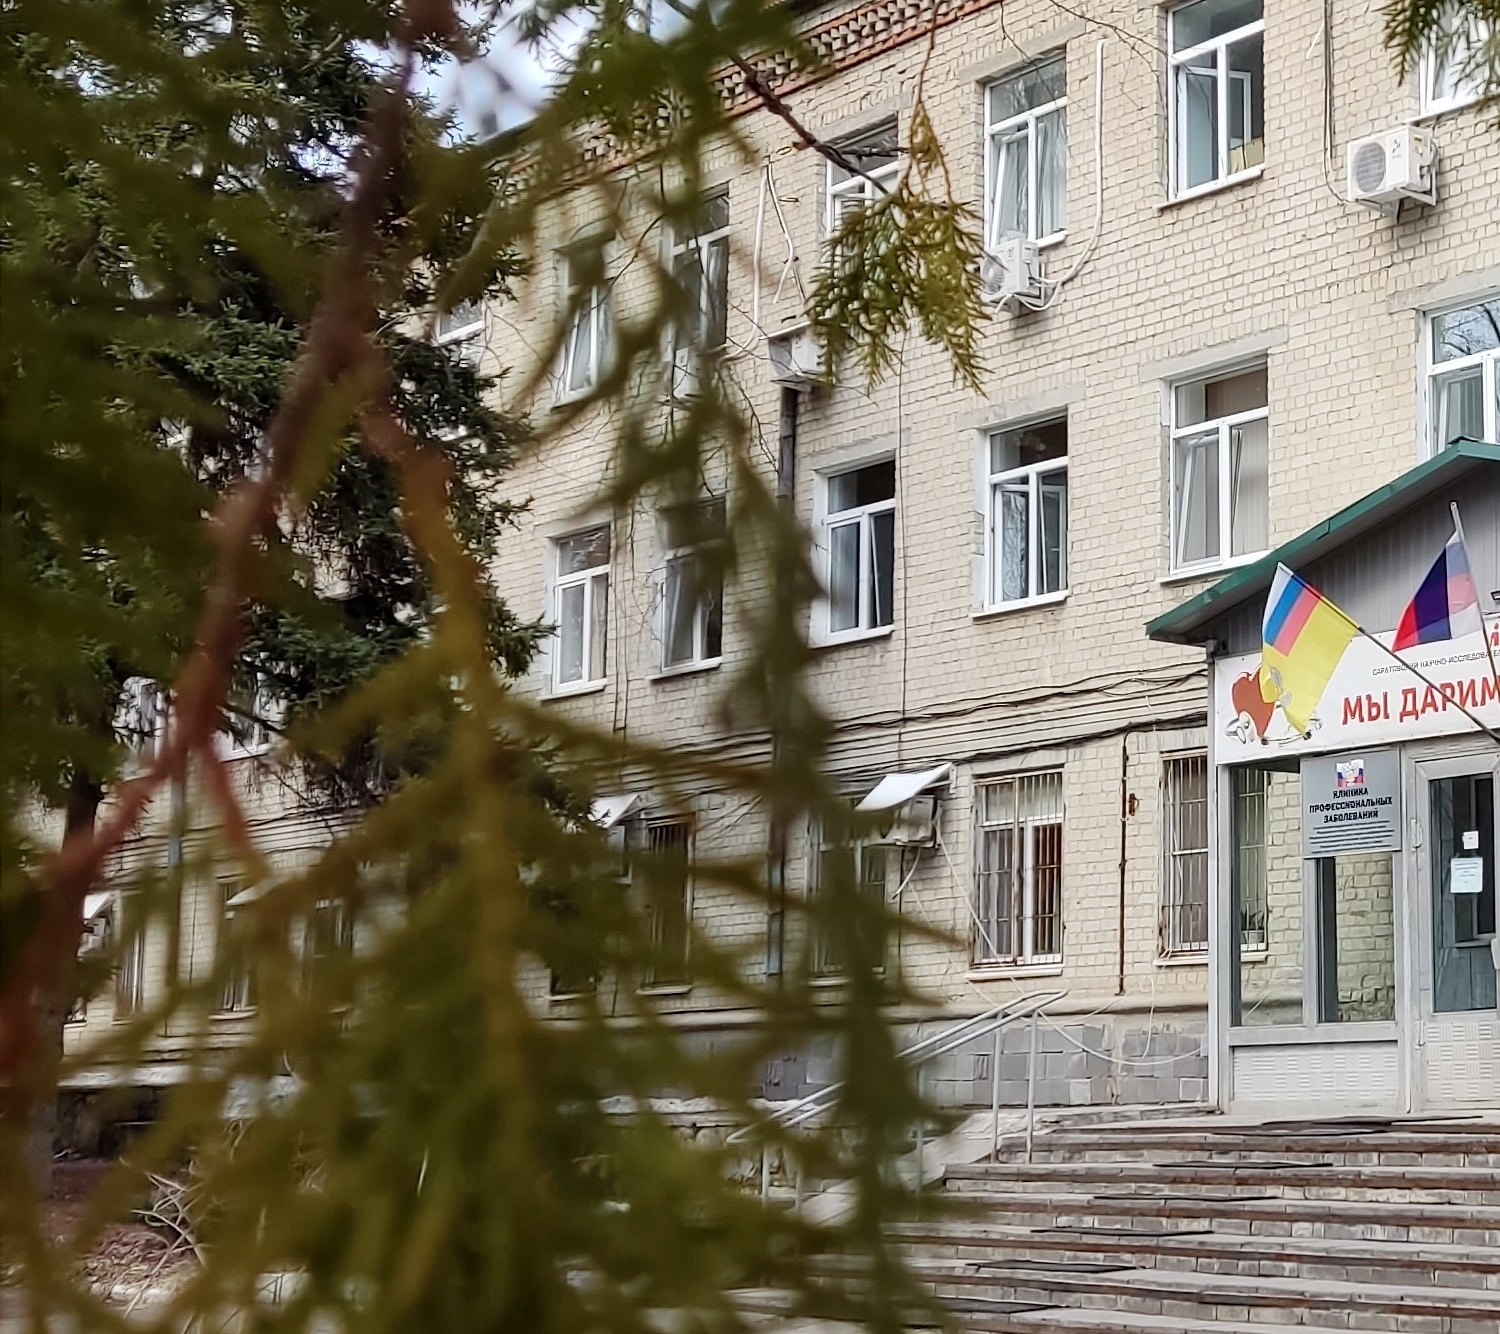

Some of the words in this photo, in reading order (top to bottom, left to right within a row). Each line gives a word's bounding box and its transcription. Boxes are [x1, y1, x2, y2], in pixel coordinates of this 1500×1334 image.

[1372, 661, 1419, 675] САРАТОВСИЙ
[1342, 691, 1390, 725] МЫ
[1333, 787, 1369, 799] КЛИНИКА
[1309, 796, 1393, 814] ПРОФЕССИОНАЛЬНЫХ
[1323, 807, 1379, 823] ЗАБОЛЕВАНИЙ
